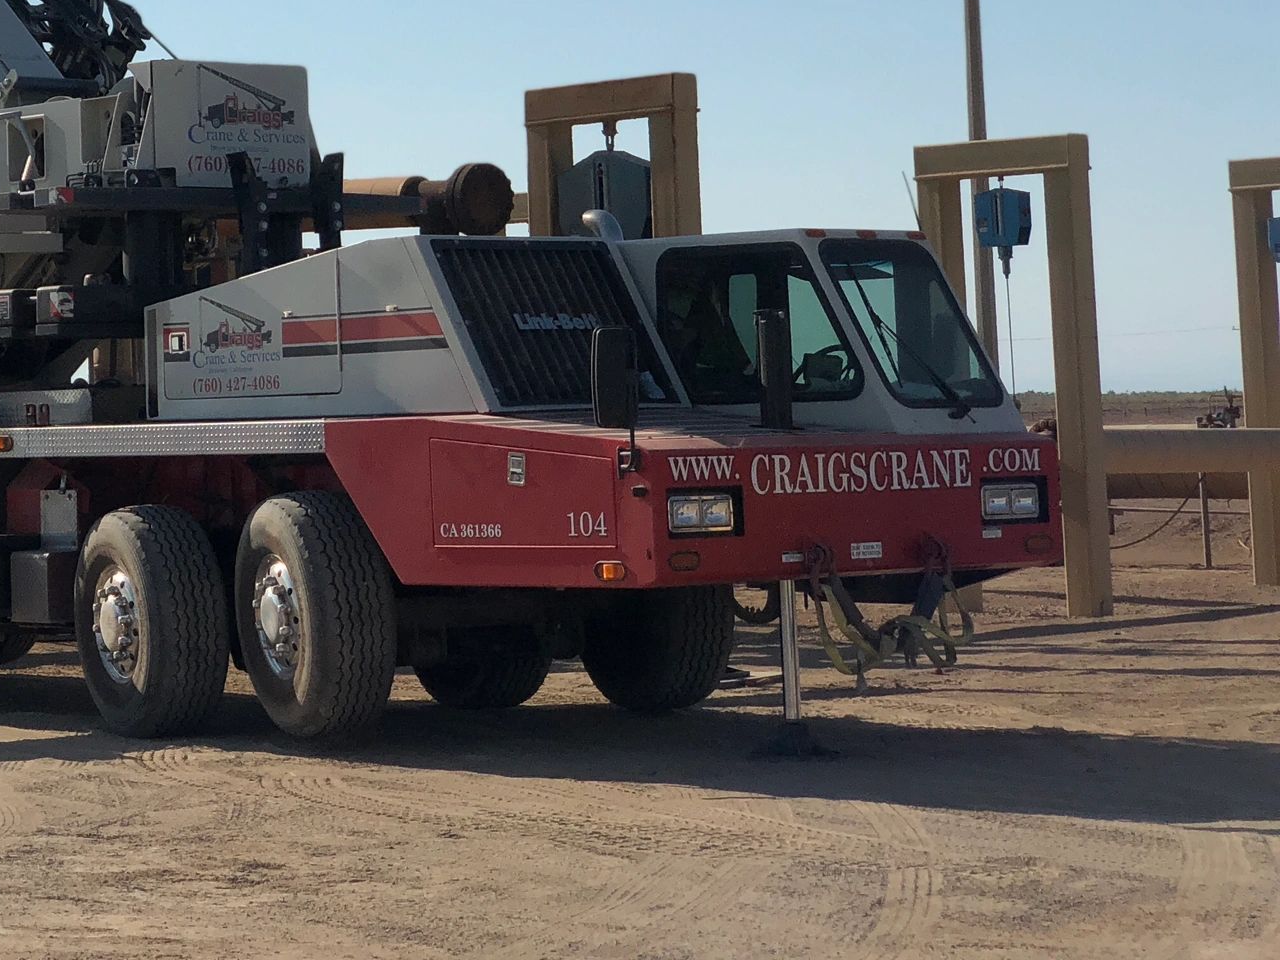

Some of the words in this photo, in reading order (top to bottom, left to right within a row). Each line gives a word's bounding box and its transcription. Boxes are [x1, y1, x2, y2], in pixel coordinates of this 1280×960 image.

[187, 123, 233, 145] Crane
[237, 130, 250, 143] &
[253, 129, 306, 145] Services
[512, 312, 601, 330] Link-Belt
[192, 350, 226, 369] Crane
[228, 351, 238, 364] &
[240, 350, 281, 364] Services
[192, 376, 222, 395] (760)
[225, 374, 281, 392] 427-4086
[668, 455, 740, 481] WWW.
[750, 449, 972, 495] CRAIGSCRANE
[982, 448, 1041, 473] .COM
[440, 522, 458, 538] CA
[460, 523, 502, 538] 361366
[566, 511, 608, 537] 104
